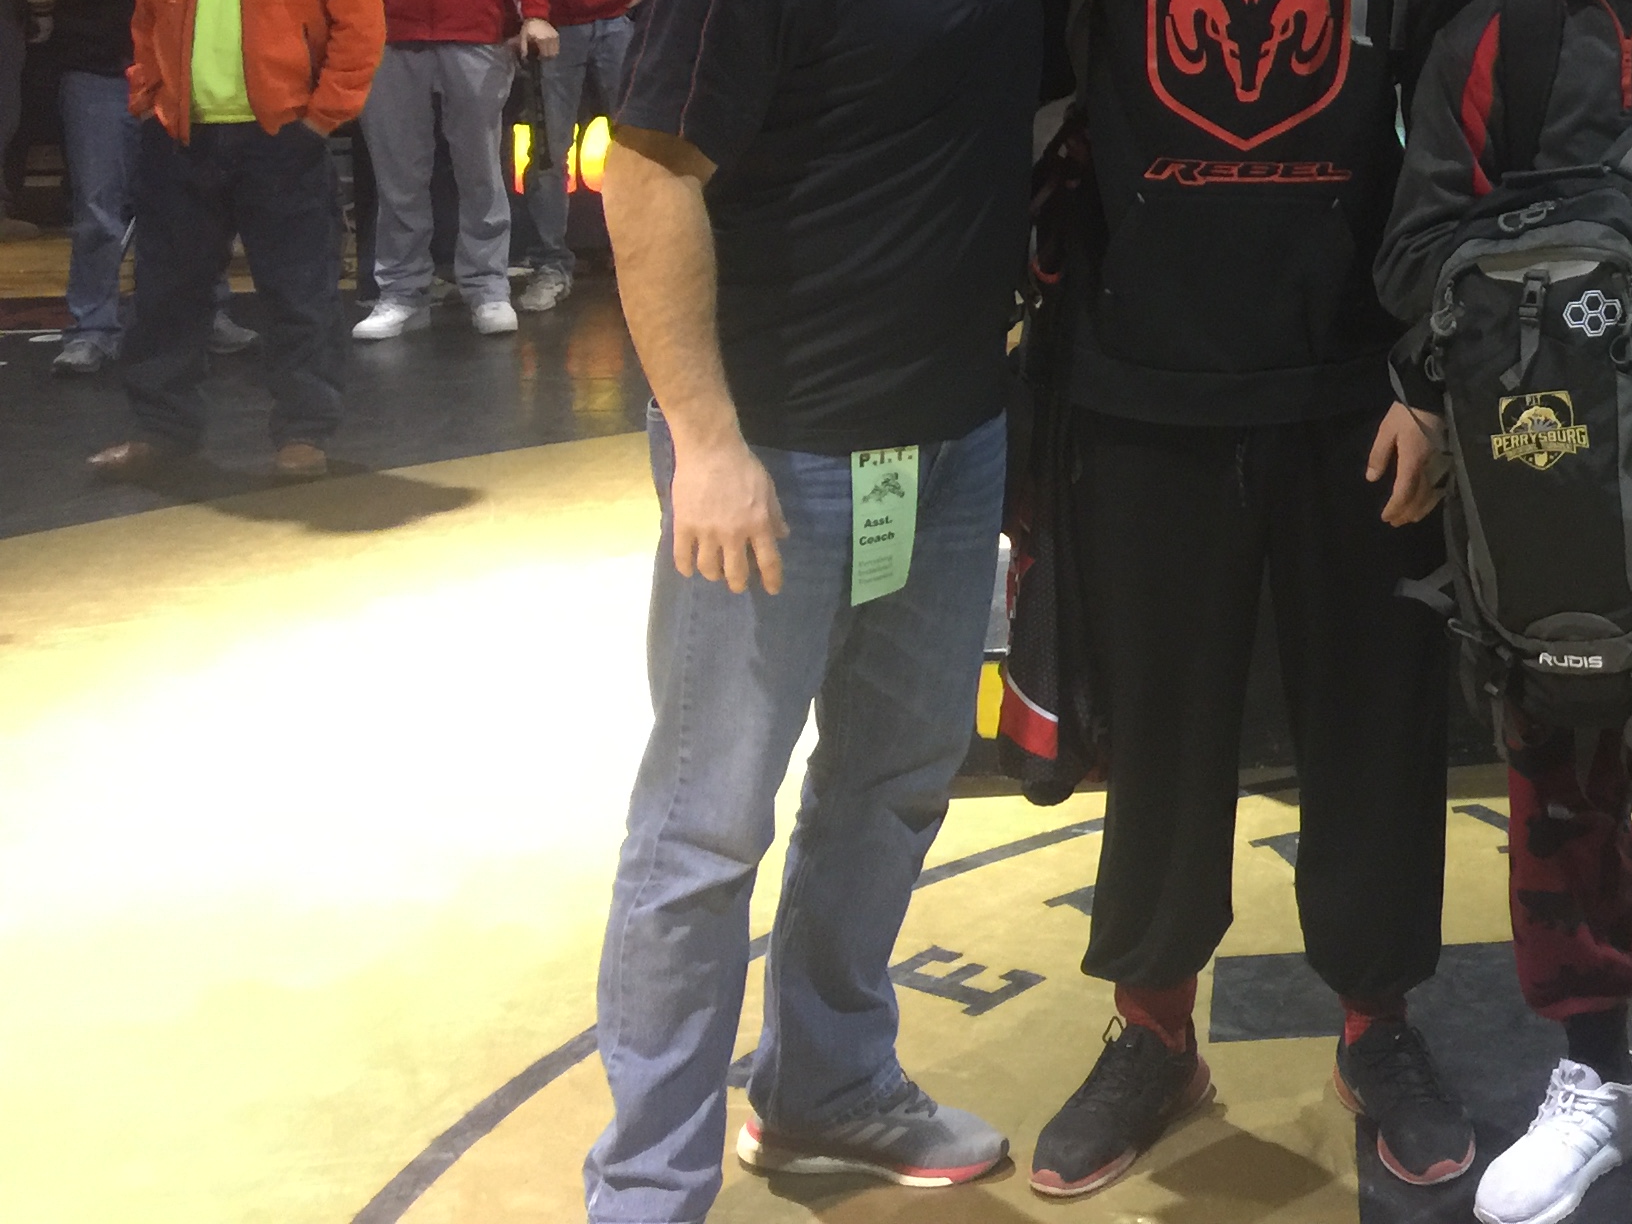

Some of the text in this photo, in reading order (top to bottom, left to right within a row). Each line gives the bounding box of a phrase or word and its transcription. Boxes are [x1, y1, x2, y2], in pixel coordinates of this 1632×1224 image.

[1143, 157, 1353, 186] REBEL
[1493, 427, 1587, 457] PERRYSBURG
[859, 530, 896, 546] Coach
[1538, 652, 1603, 669] RUDIS
